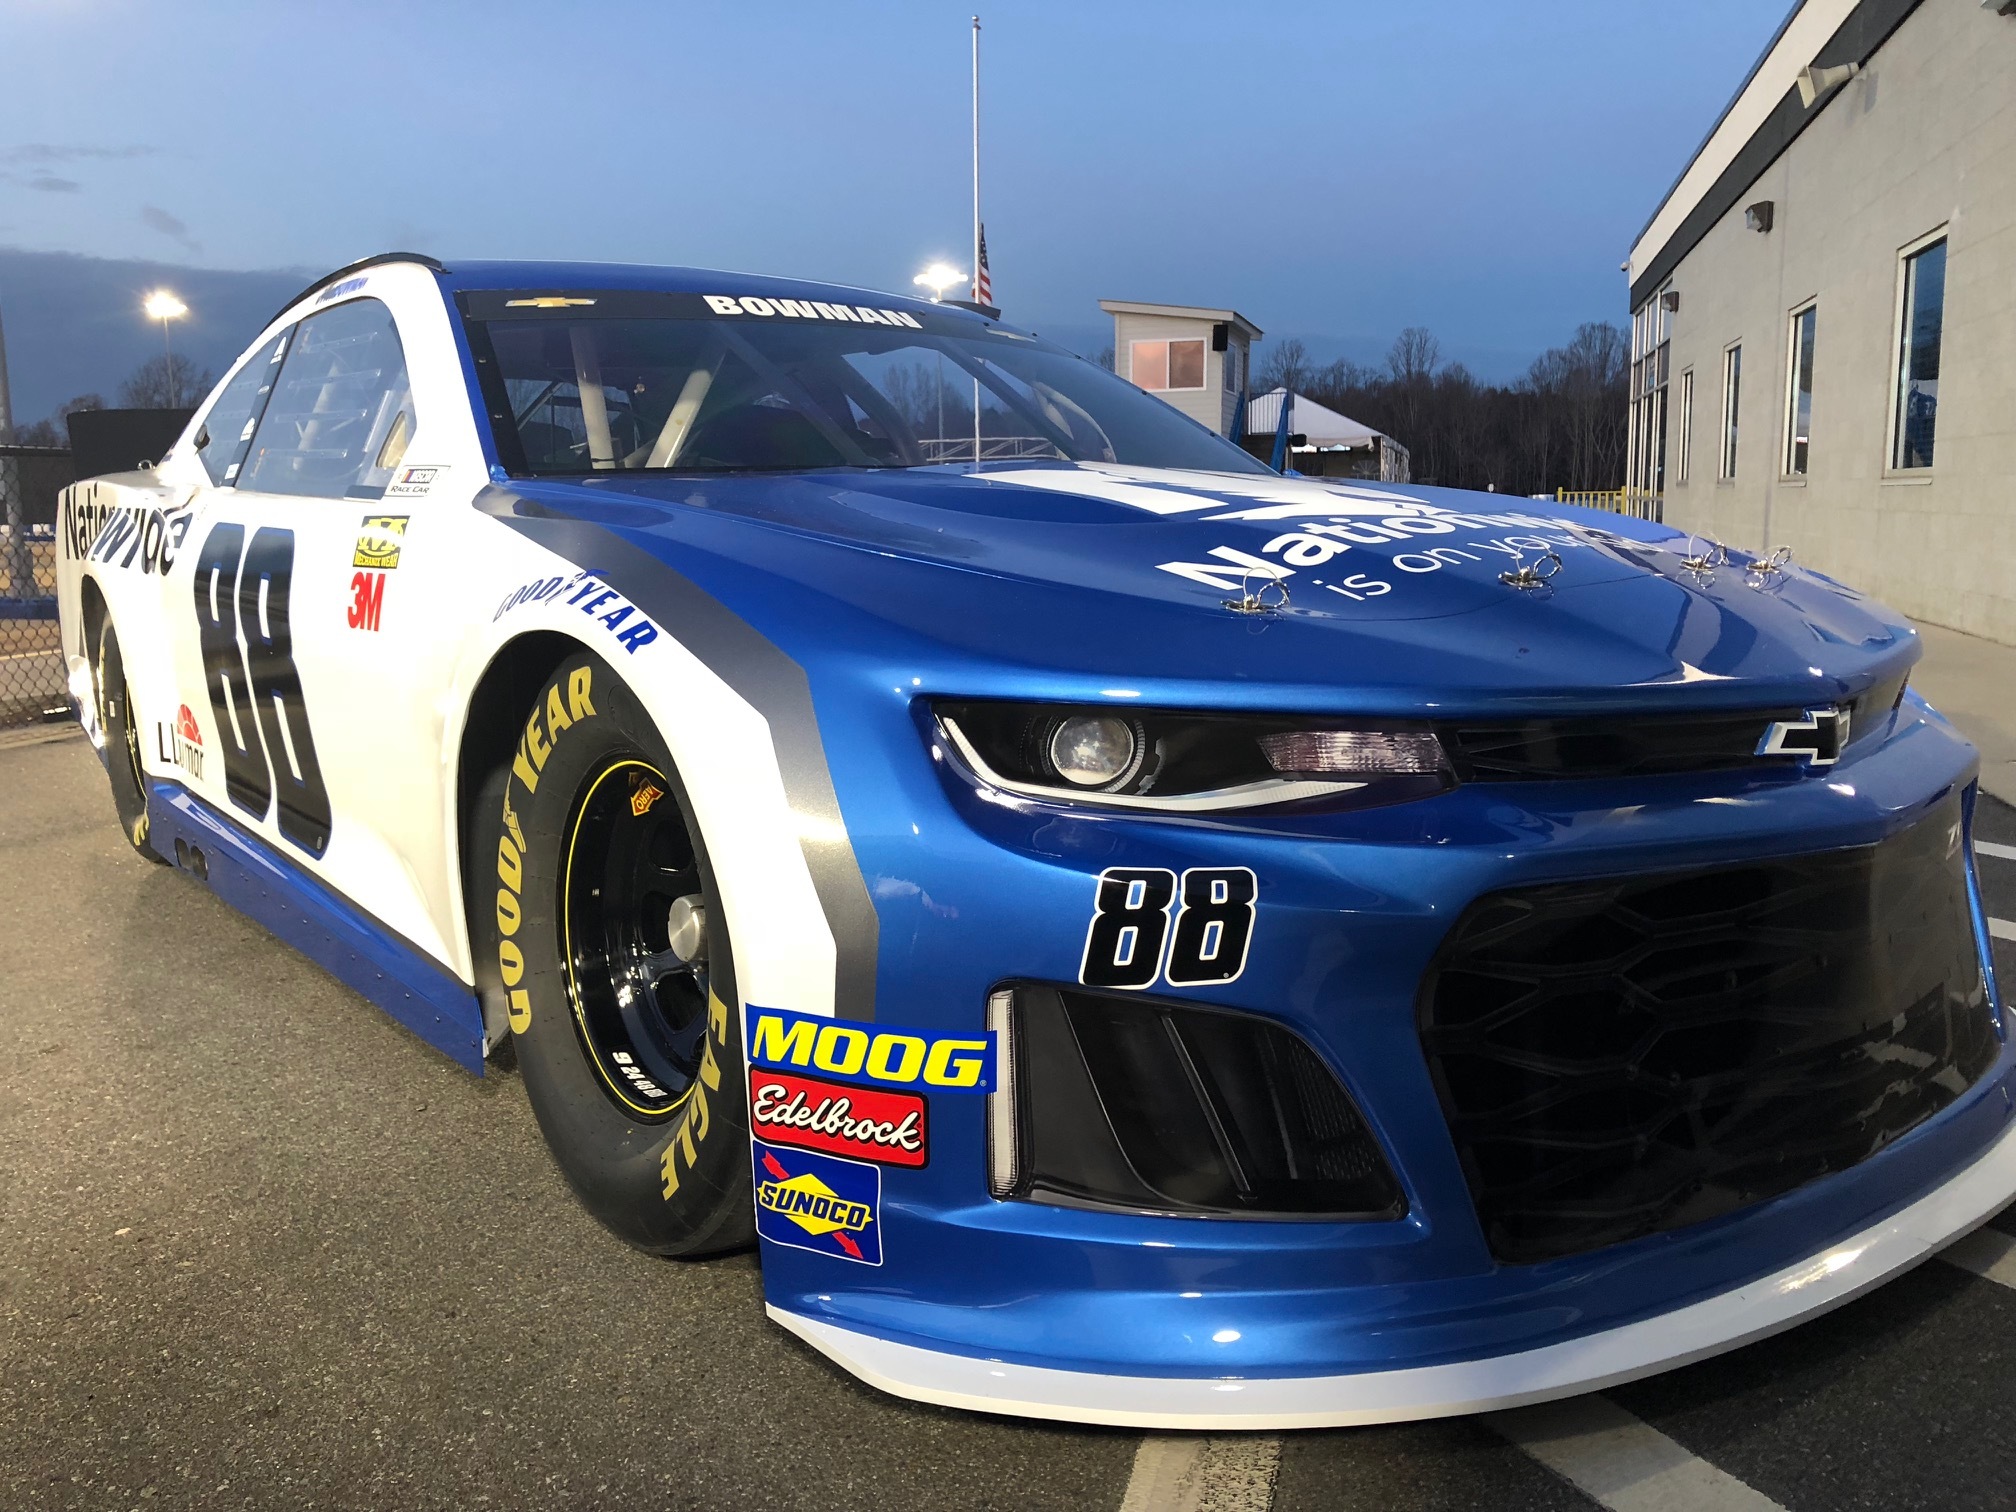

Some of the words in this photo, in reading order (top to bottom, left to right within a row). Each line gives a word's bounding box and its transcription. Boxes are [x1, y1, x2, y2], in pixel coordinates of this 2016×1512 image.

[702, 295, 923, 329] BOWMAN
[412, 485, 430, 494] CAR
[1154, 513, 1613, 591] Nationw
[1312, 573, 1392, 601] is
[1392, 546, 1462, 573] on
[347, 571, 386, 632] 3M
[194, 522, 332, 861] 88
[636, 785, 653, 810] AERO
[1078, 866, 1258, 990] 88
[753, 1015, 988, 1087] MOOG
[661, 982, 727, 1201] EAGLE
[753, 1084, 921, 1150] Edelbrock
[761, 1184, 867, 1228] SUNOCO
